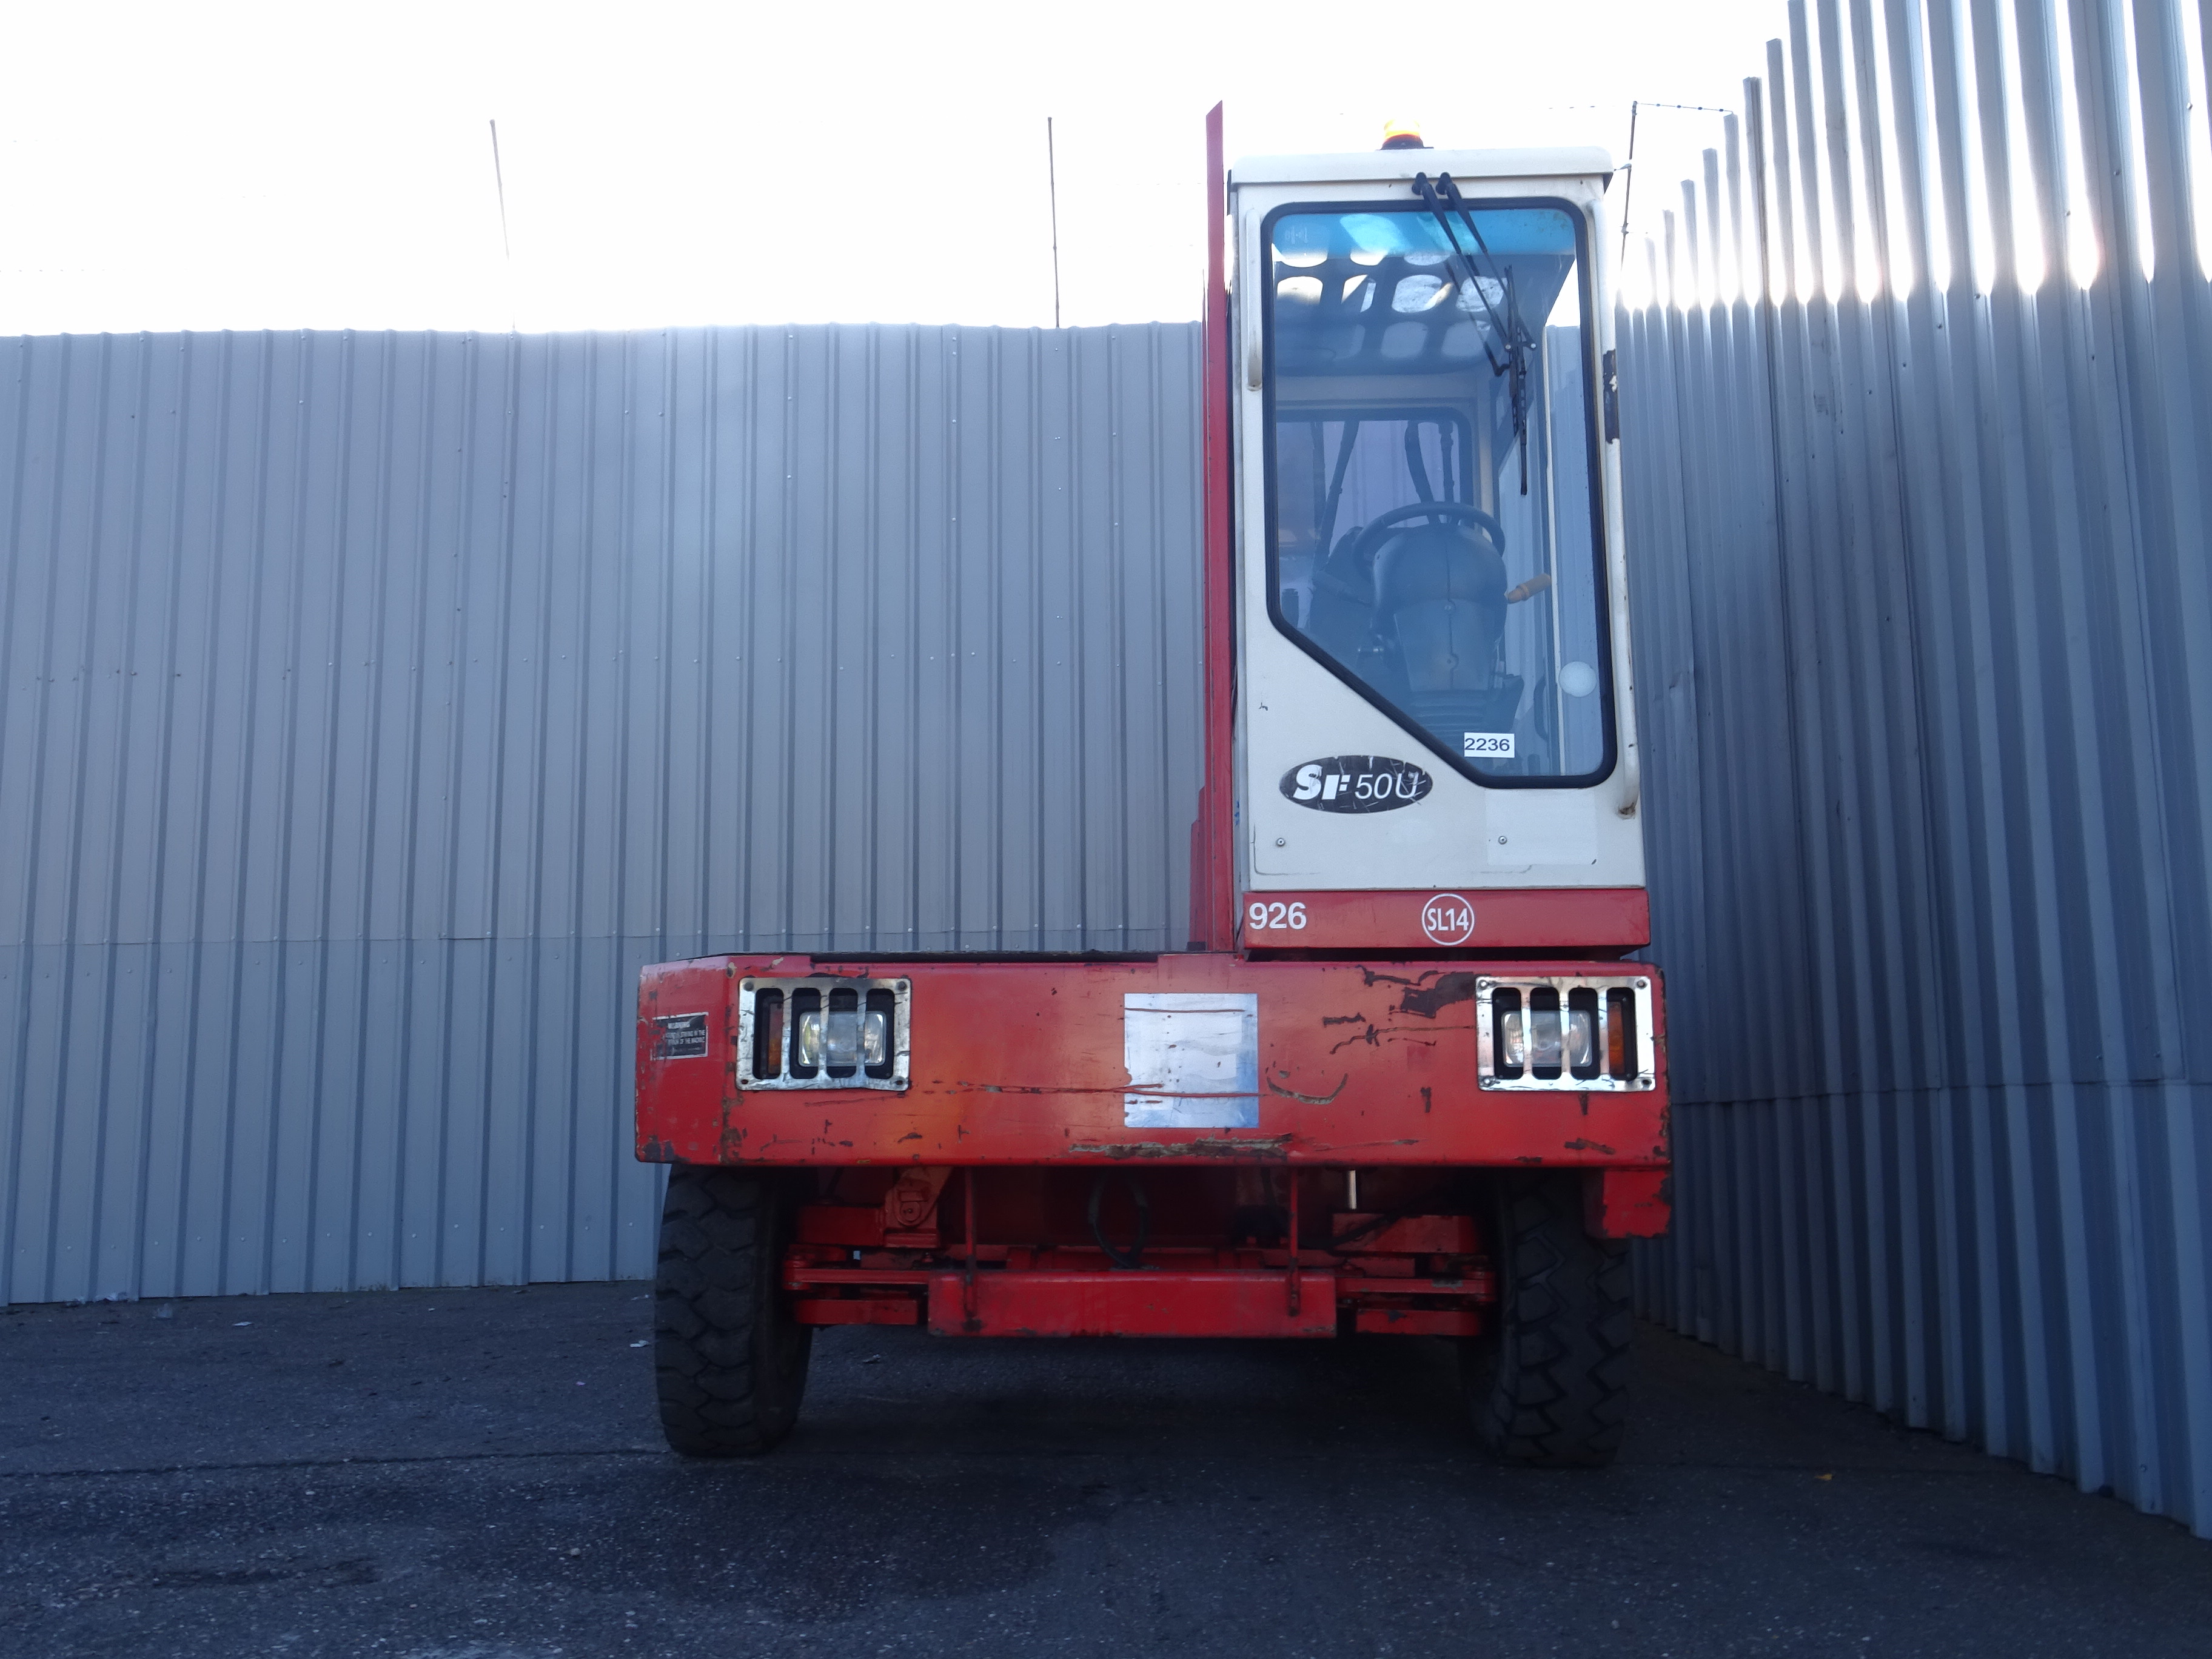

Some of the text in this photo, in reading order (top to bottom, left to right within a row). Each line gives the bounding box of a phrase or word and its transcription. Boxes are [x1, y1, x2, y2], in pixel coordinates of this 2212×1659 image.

[1464, 738, 1510, 751] 2236
[1293, 764, 1419, 800] SF 50U
[1249, 902, 1307, 930] 926
[1427, 908, 1469, 931] SL14
